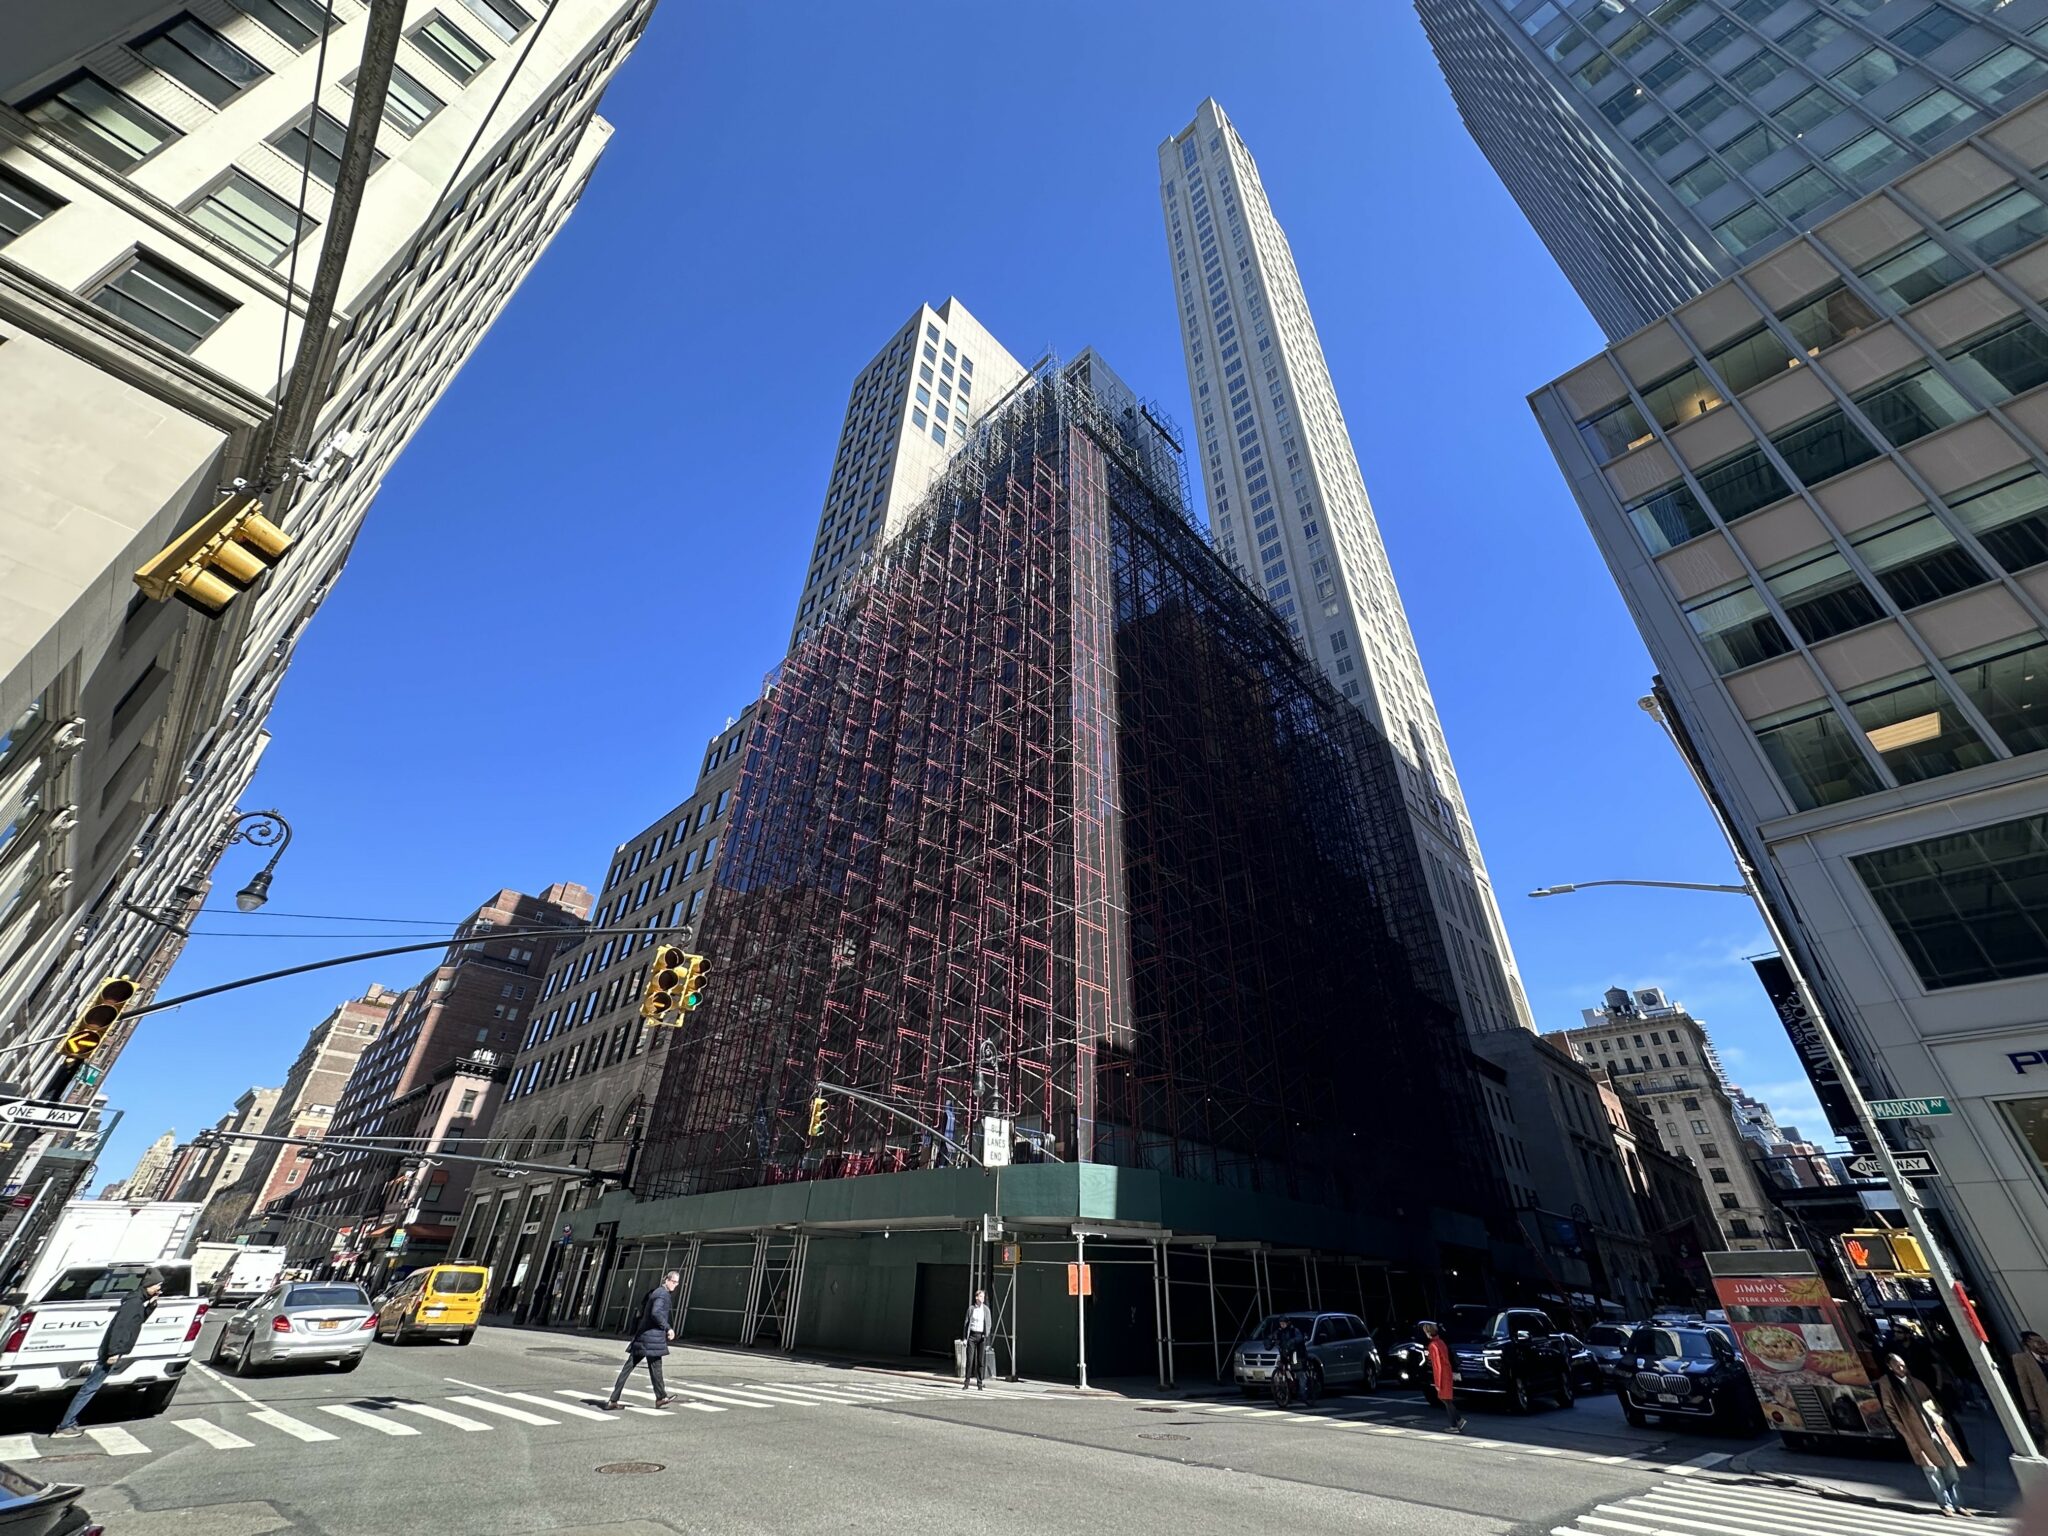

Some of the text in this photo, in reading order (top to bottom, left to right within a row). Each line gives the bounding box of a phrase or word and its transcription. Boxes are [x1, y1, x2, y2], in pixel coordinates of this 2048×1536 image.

[2004, 1050, 2048, 1074] P
[7, 1106, 77, 1121] ONE WAY
[1873, 1099, 1942, 1117] MADISON AV
[987, 1137, 1005, 1148] LANES
[991, 1151, 1001, 1161] END
[1858, 1161, 1881, 1171] ONE
[1734, 1284, 1786, 1293] JIMMY'S
